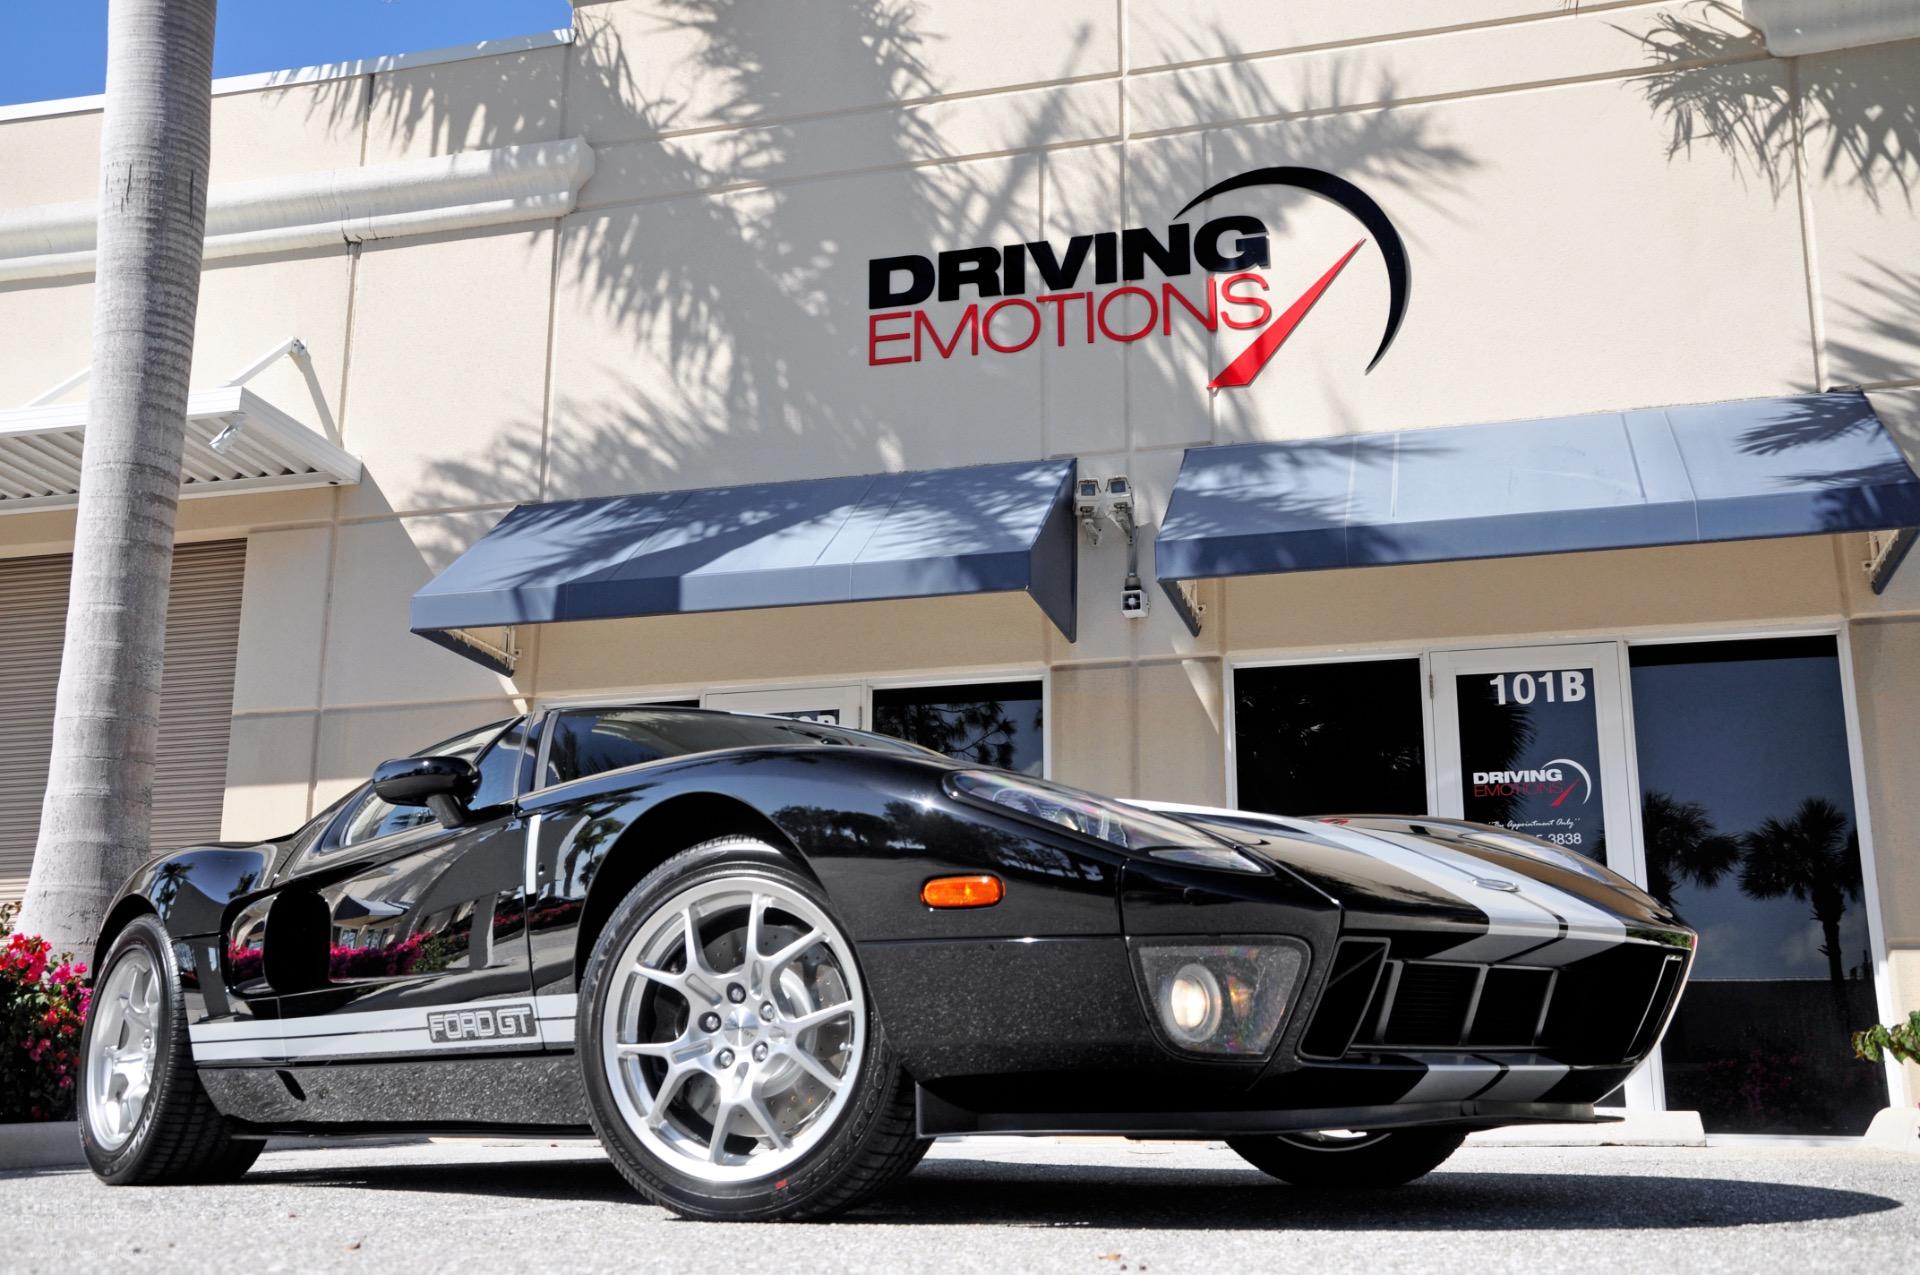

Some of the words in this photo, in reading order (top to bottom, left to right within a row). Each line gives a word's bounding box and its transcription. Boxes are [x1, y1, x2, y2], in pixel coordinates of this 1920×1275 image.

[868, 215, 1271, 310] DRIVING
[868, 273, 1272, 366] EMOTIONS
[1489, 671, 1586, 705] 101B
[1473, 769, 1563, 785] DRIVING
[1474, 783, 1563, 798] EMOTIONS
[430, 1012, 495, 1040] FORD
[497, 1007, 532, 1035] GT
